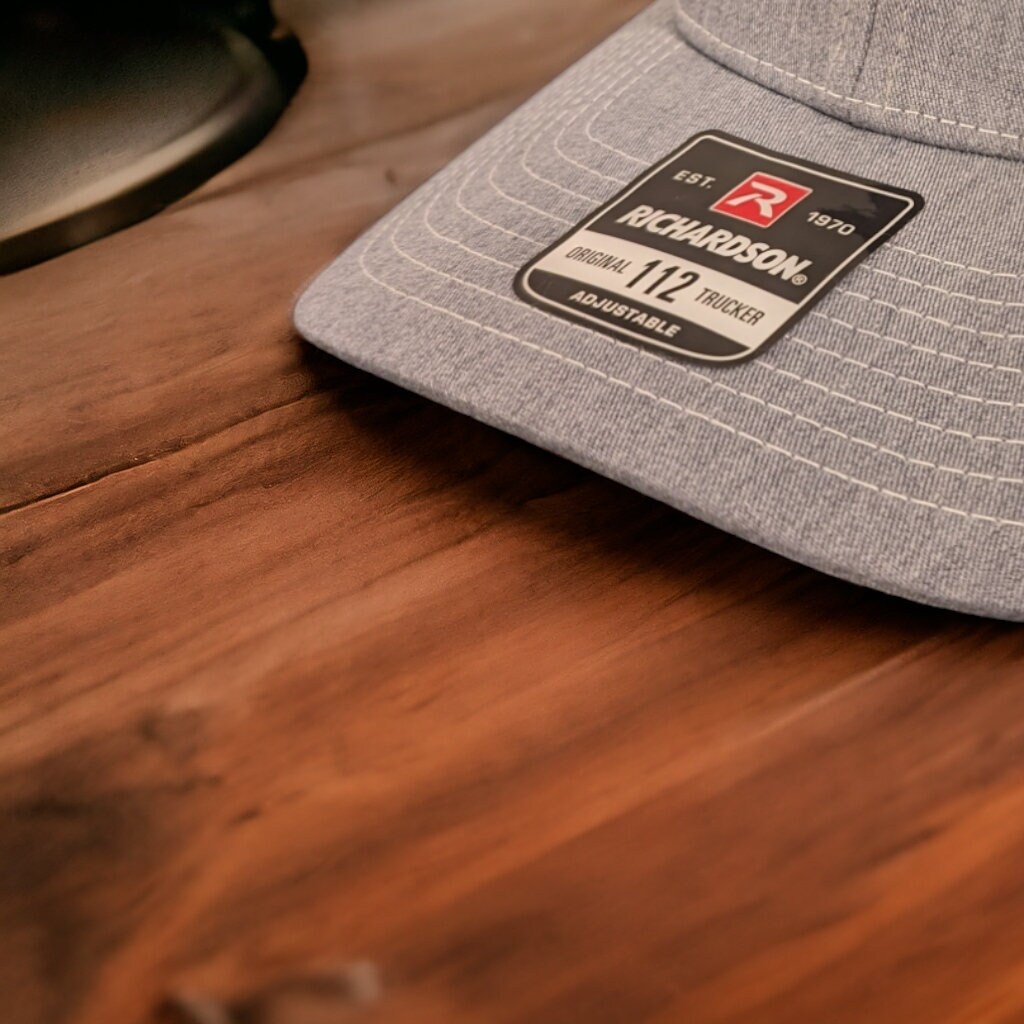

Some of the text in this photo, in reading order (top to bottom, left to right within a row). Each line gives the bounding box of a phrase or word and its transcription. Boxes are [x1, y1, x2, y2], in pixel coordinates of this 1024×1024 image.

[673, 170, 717, 190] EST.
[807, 210, 856, 236] 1970
[565, 246, 766, 327] ORIGINAL 112 TRUCKER
[569, 289, 682, 338] ADJUSTABLE
